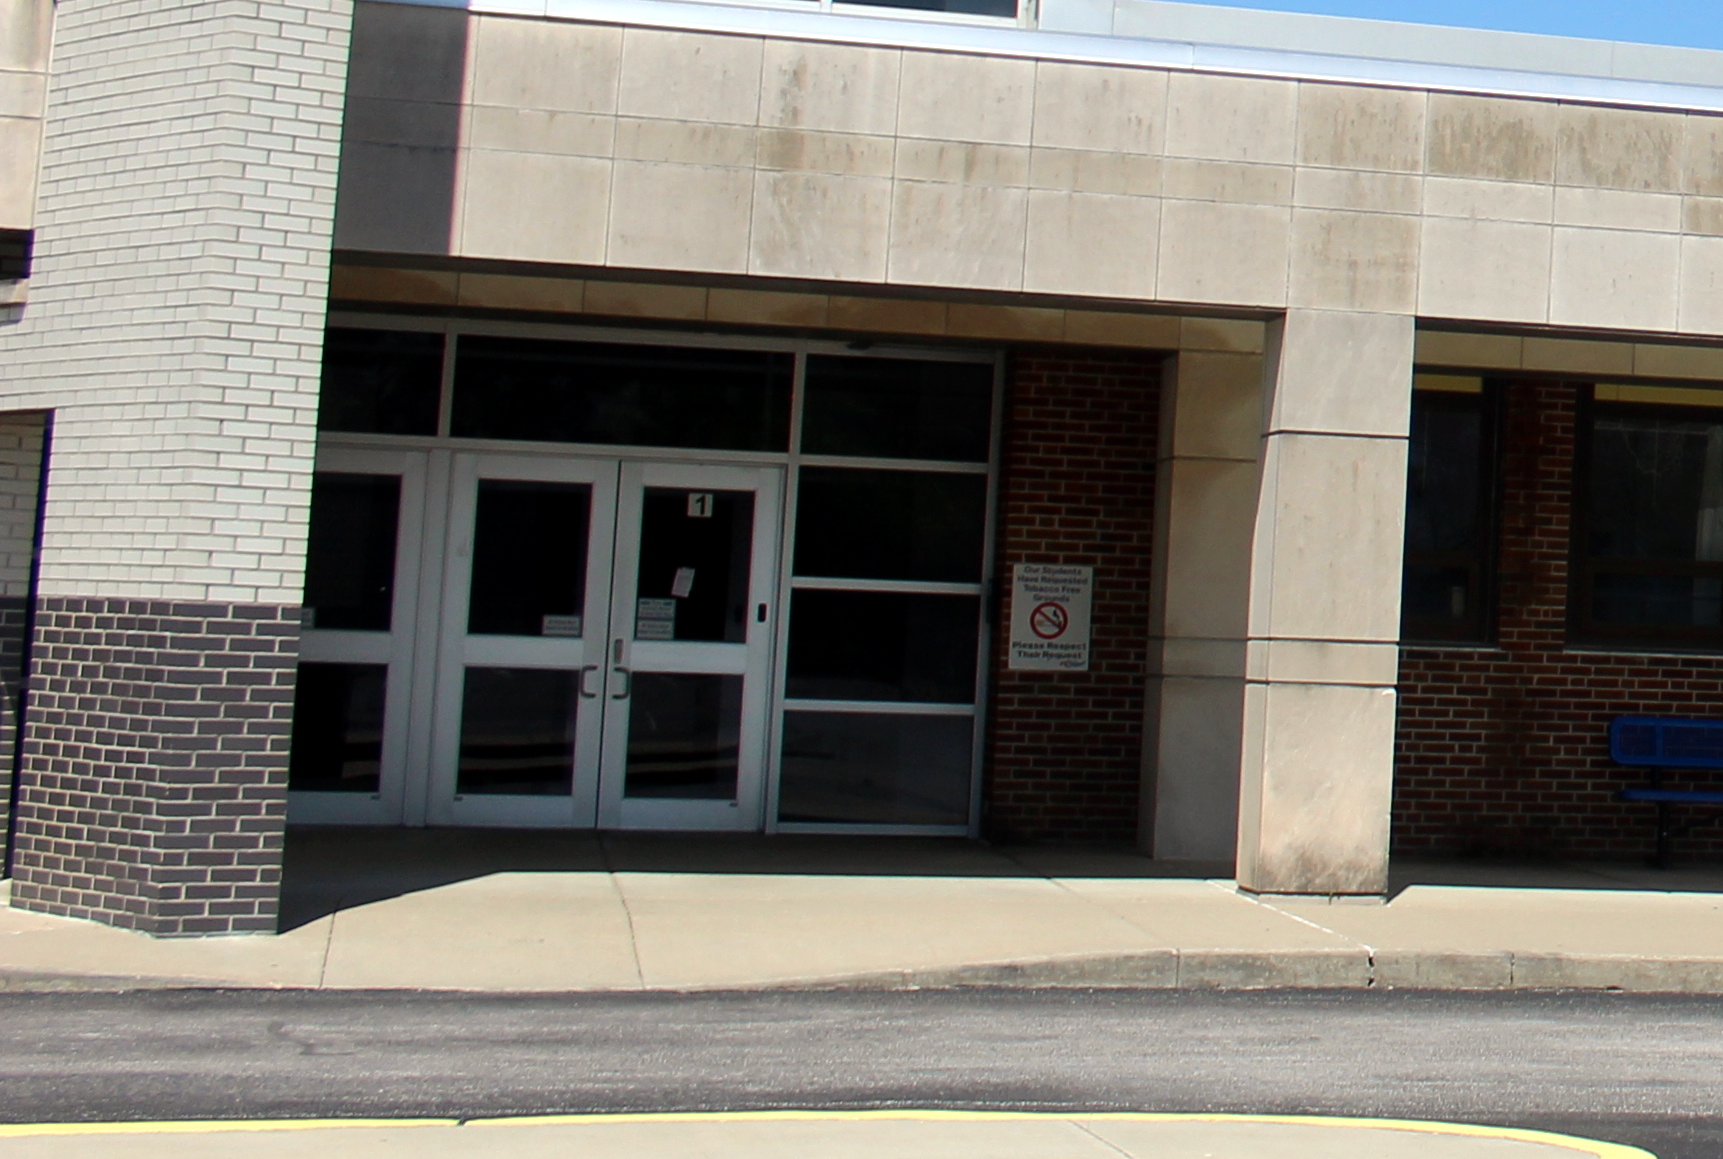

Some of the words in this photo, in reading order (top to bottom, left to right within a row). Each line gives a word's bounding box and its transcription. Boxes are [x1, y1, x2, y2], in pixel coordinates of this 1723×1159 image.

[695, 494, 706, 516] 1
[1042, 566, 1082, 575] Students
[1017, 574, 1039, 582] Have
[1040, 575, 1088, 585] Requested
[1024, 584, 1060, 593] Tobacco
[1062, 585, 1081, 593] Free
[1033, 593, 1070, 602] Grounds
[1012, 641, 1044, 649] Please
[1047, 642, 1086, 651] Respect
[1017, 650, 1041, 658] Their
[1042, 651, 1082, 660] Request
